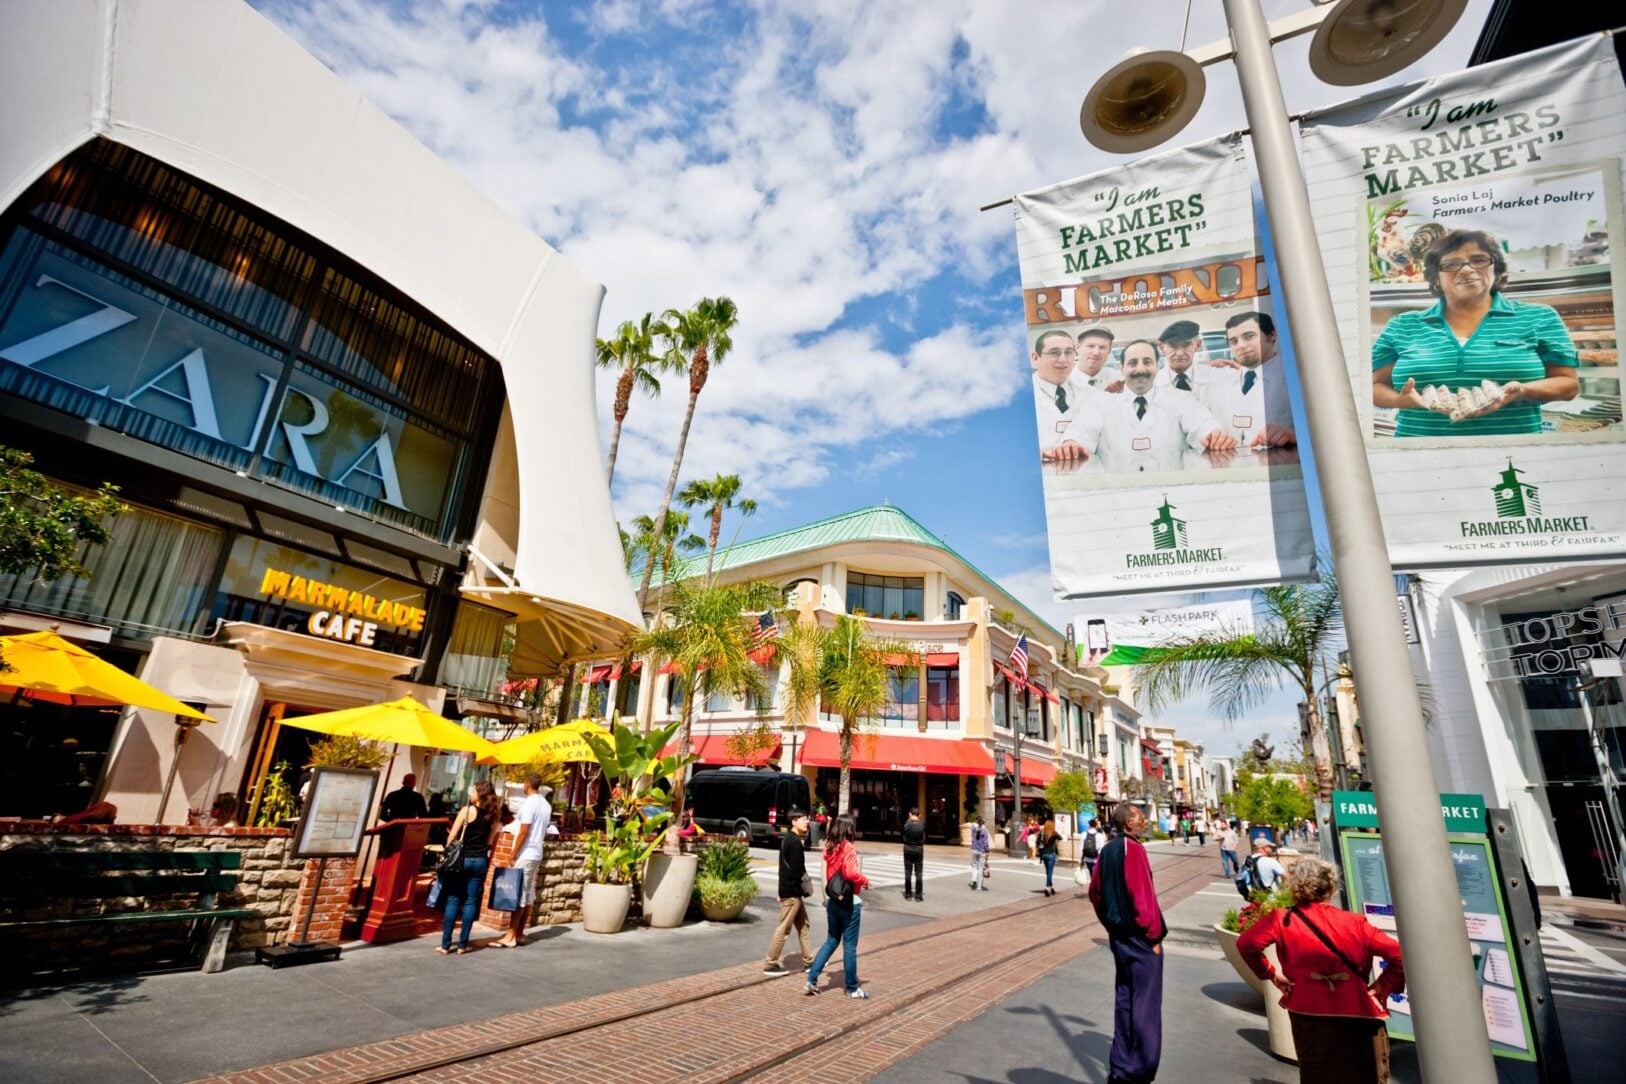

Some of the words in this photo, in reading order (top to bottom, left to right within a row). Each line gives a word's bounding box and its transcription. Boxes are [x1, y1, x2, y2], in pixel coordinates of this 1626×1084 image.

[1446, 98, 1498, 123] am
[1360, 103, 1561, 170] FARMERS
[1364, 130, 1564, 199] MARKET”
[1124, 186, 1161, 207] am
[1432, 193, 1468, 205] Sonia
[1472, 189, 1494, 200] Laj
[1432, 205, 1486, 219] Farmers
[1491, 195, 1539, 211] Market
[1543, 190, 1595, 204] Poultry
[1059, 193, 1205, 249] FARMERS
[1063, 221, 1207, 274] MARKET”
[1100, 294, 1118, 304] The
[1120, 290, 1157, 302] DeRosa
[1160, 283, 1193, 297] Family
[1100, 300, 1154, 314] Marconda's
[1157, 296, 1187, 308] Meats
[0, 273, 411, 512] ZARA
[1460, 520, 1525, 537] FARMERS
[1526, 516, 1589, 534] MARKET
[1480, 542, 1495, 550] ME
[1499, 541, 1511, 549] AT
[1514, 539, 1548, 548] THIRD
[1126, 551, 1175, 568] FARMERS
[1175, 547, 1223, 564] MARKET
[1166, 569, 1192, 577] THIRD
[260, 567, 426, 632] MARMALADE
[307, 610, 378, 646] CAFE
[1340, 802, 1378, 816] FARM
[1441, 806, 1479, 819] RKET
